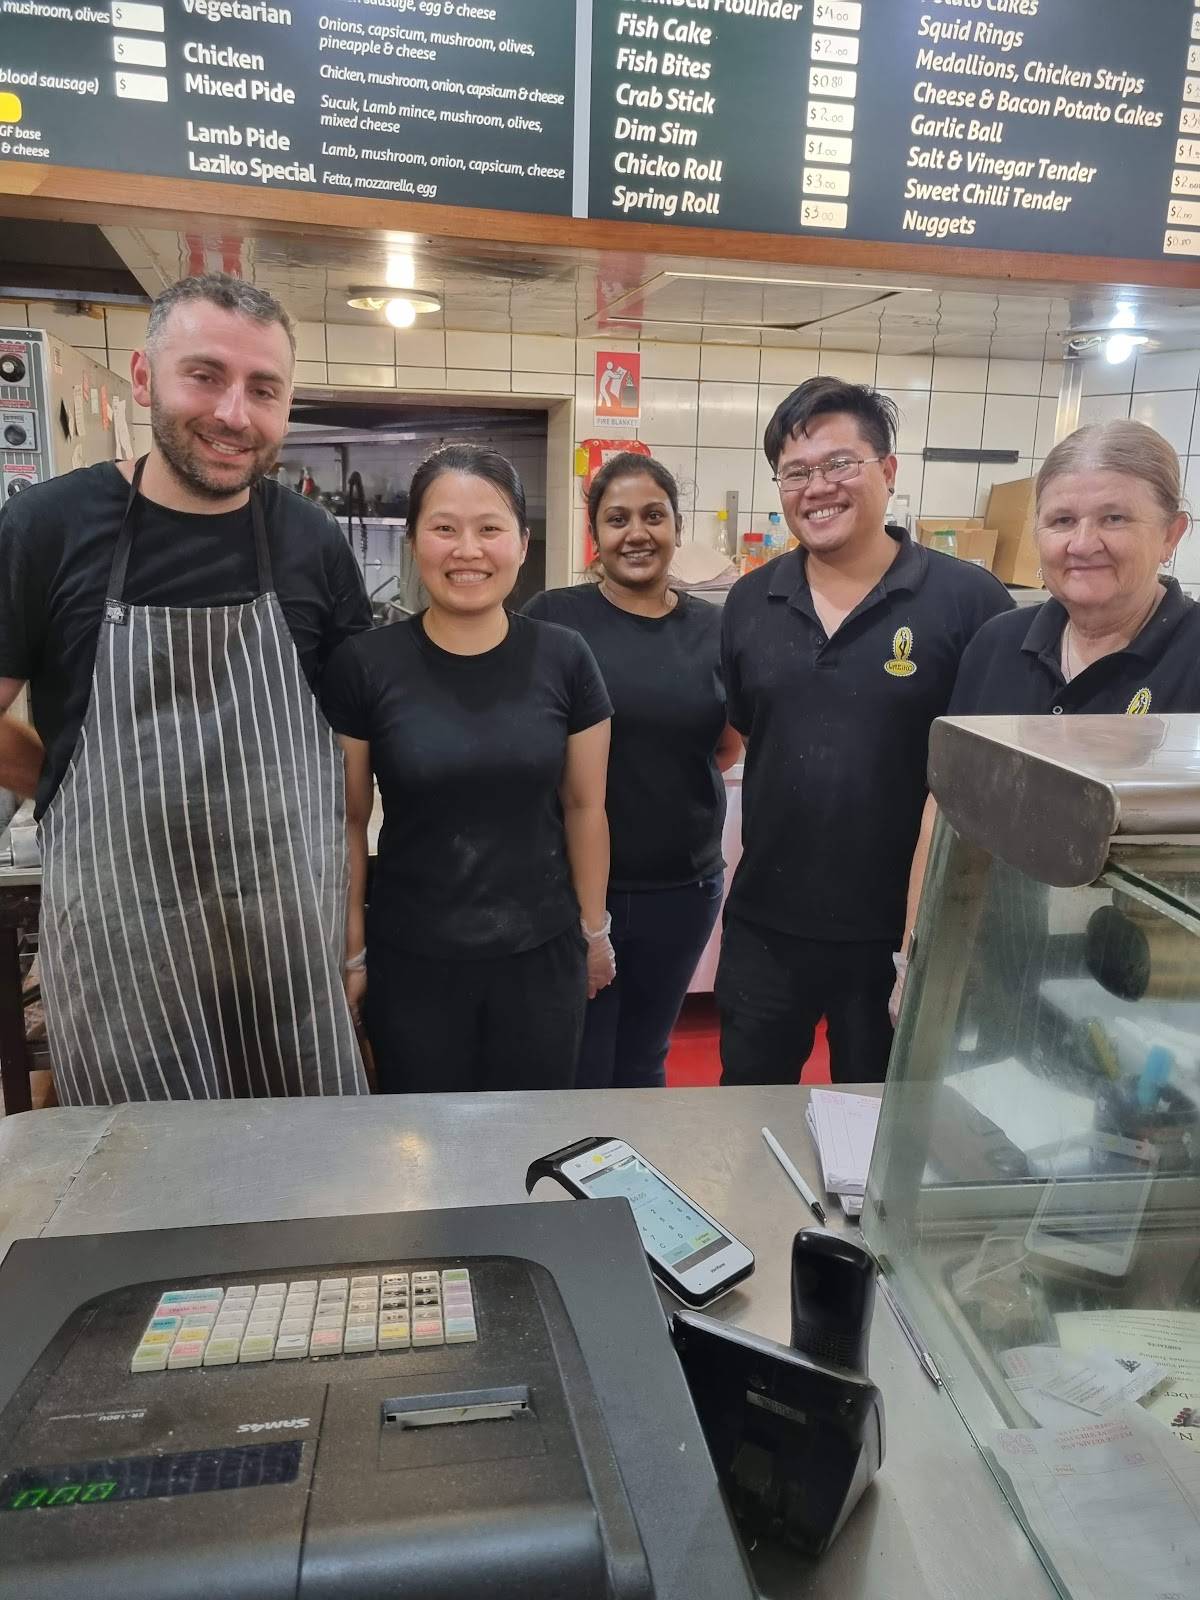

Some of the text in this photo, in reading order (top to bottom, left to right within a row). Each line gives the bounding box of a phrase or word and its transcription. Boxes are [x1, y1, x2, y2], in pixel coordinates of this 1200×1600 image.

[3, 1, 110, 23] mushroom, olives
[183, 0, 292, 25] Vegetarian
[419, 2, 441, 16] egg
[444, 1, 454, 14] &
[456, 5, 497, 20] cheese
[319, 16, 536, 56] Onions, capsicum, mushroom, olives,
[617, 13, 712, 45] Fish Cake
[918, 15, 1024, 51] Squid Rings
[184, 42, 264, 71] Chicken
[319, 36, 437, 61] pineapple & cheese
[616, 48, 711, 79] Fish Bites
[0, 68, 99, 95] blood sausage)
[320, 64, 565, 105] Chicken, mushroom, onion, capsicum & cheese
[915, 48, 1145, 97] Medallions, Chicken Strips
[185, 73, 295, 104] Mixed Pide
[616, 83, 716, 114] Crab Stick
[320, 95, 543, 133] Sucuk, Lamb mince, mushroom, olives,
[913, 81, 977, 108] Cheese
[978, 88, 995, 109] &
[996, 90, 1050, 116] Bacon
[1053, 96, 1111, 122] Potato
[1114, 103, 1164, 128] Cakes
[0, 125, 41, 140] GF base
[187, 121, 290, 151] Lamb Pide
[320, 113, 400, 133] mixed cheese
[614, 118, 697, 146] Dim Sim
[910, 114, 1004, 143] Garlic Ball
[1, 142, 50, 158] & cheese
[322, 142, 565, 179] Lamb, mushroom, onion, capsicum, cheese
[906, 146, 1097, 184] Salt & Vinegar Tender
[189, 152, 317, 184] Laziko Special
[614, 152, 722, 182] Chicko Roll
[322, 171, 438, 198] Fetta, mozzarella, egg
[904, 178, 1072, 213] Sweet Chilli Tender
[612, 185, 720, 216] Spring Roll
[902, 210, 976, 238] Nuggets
